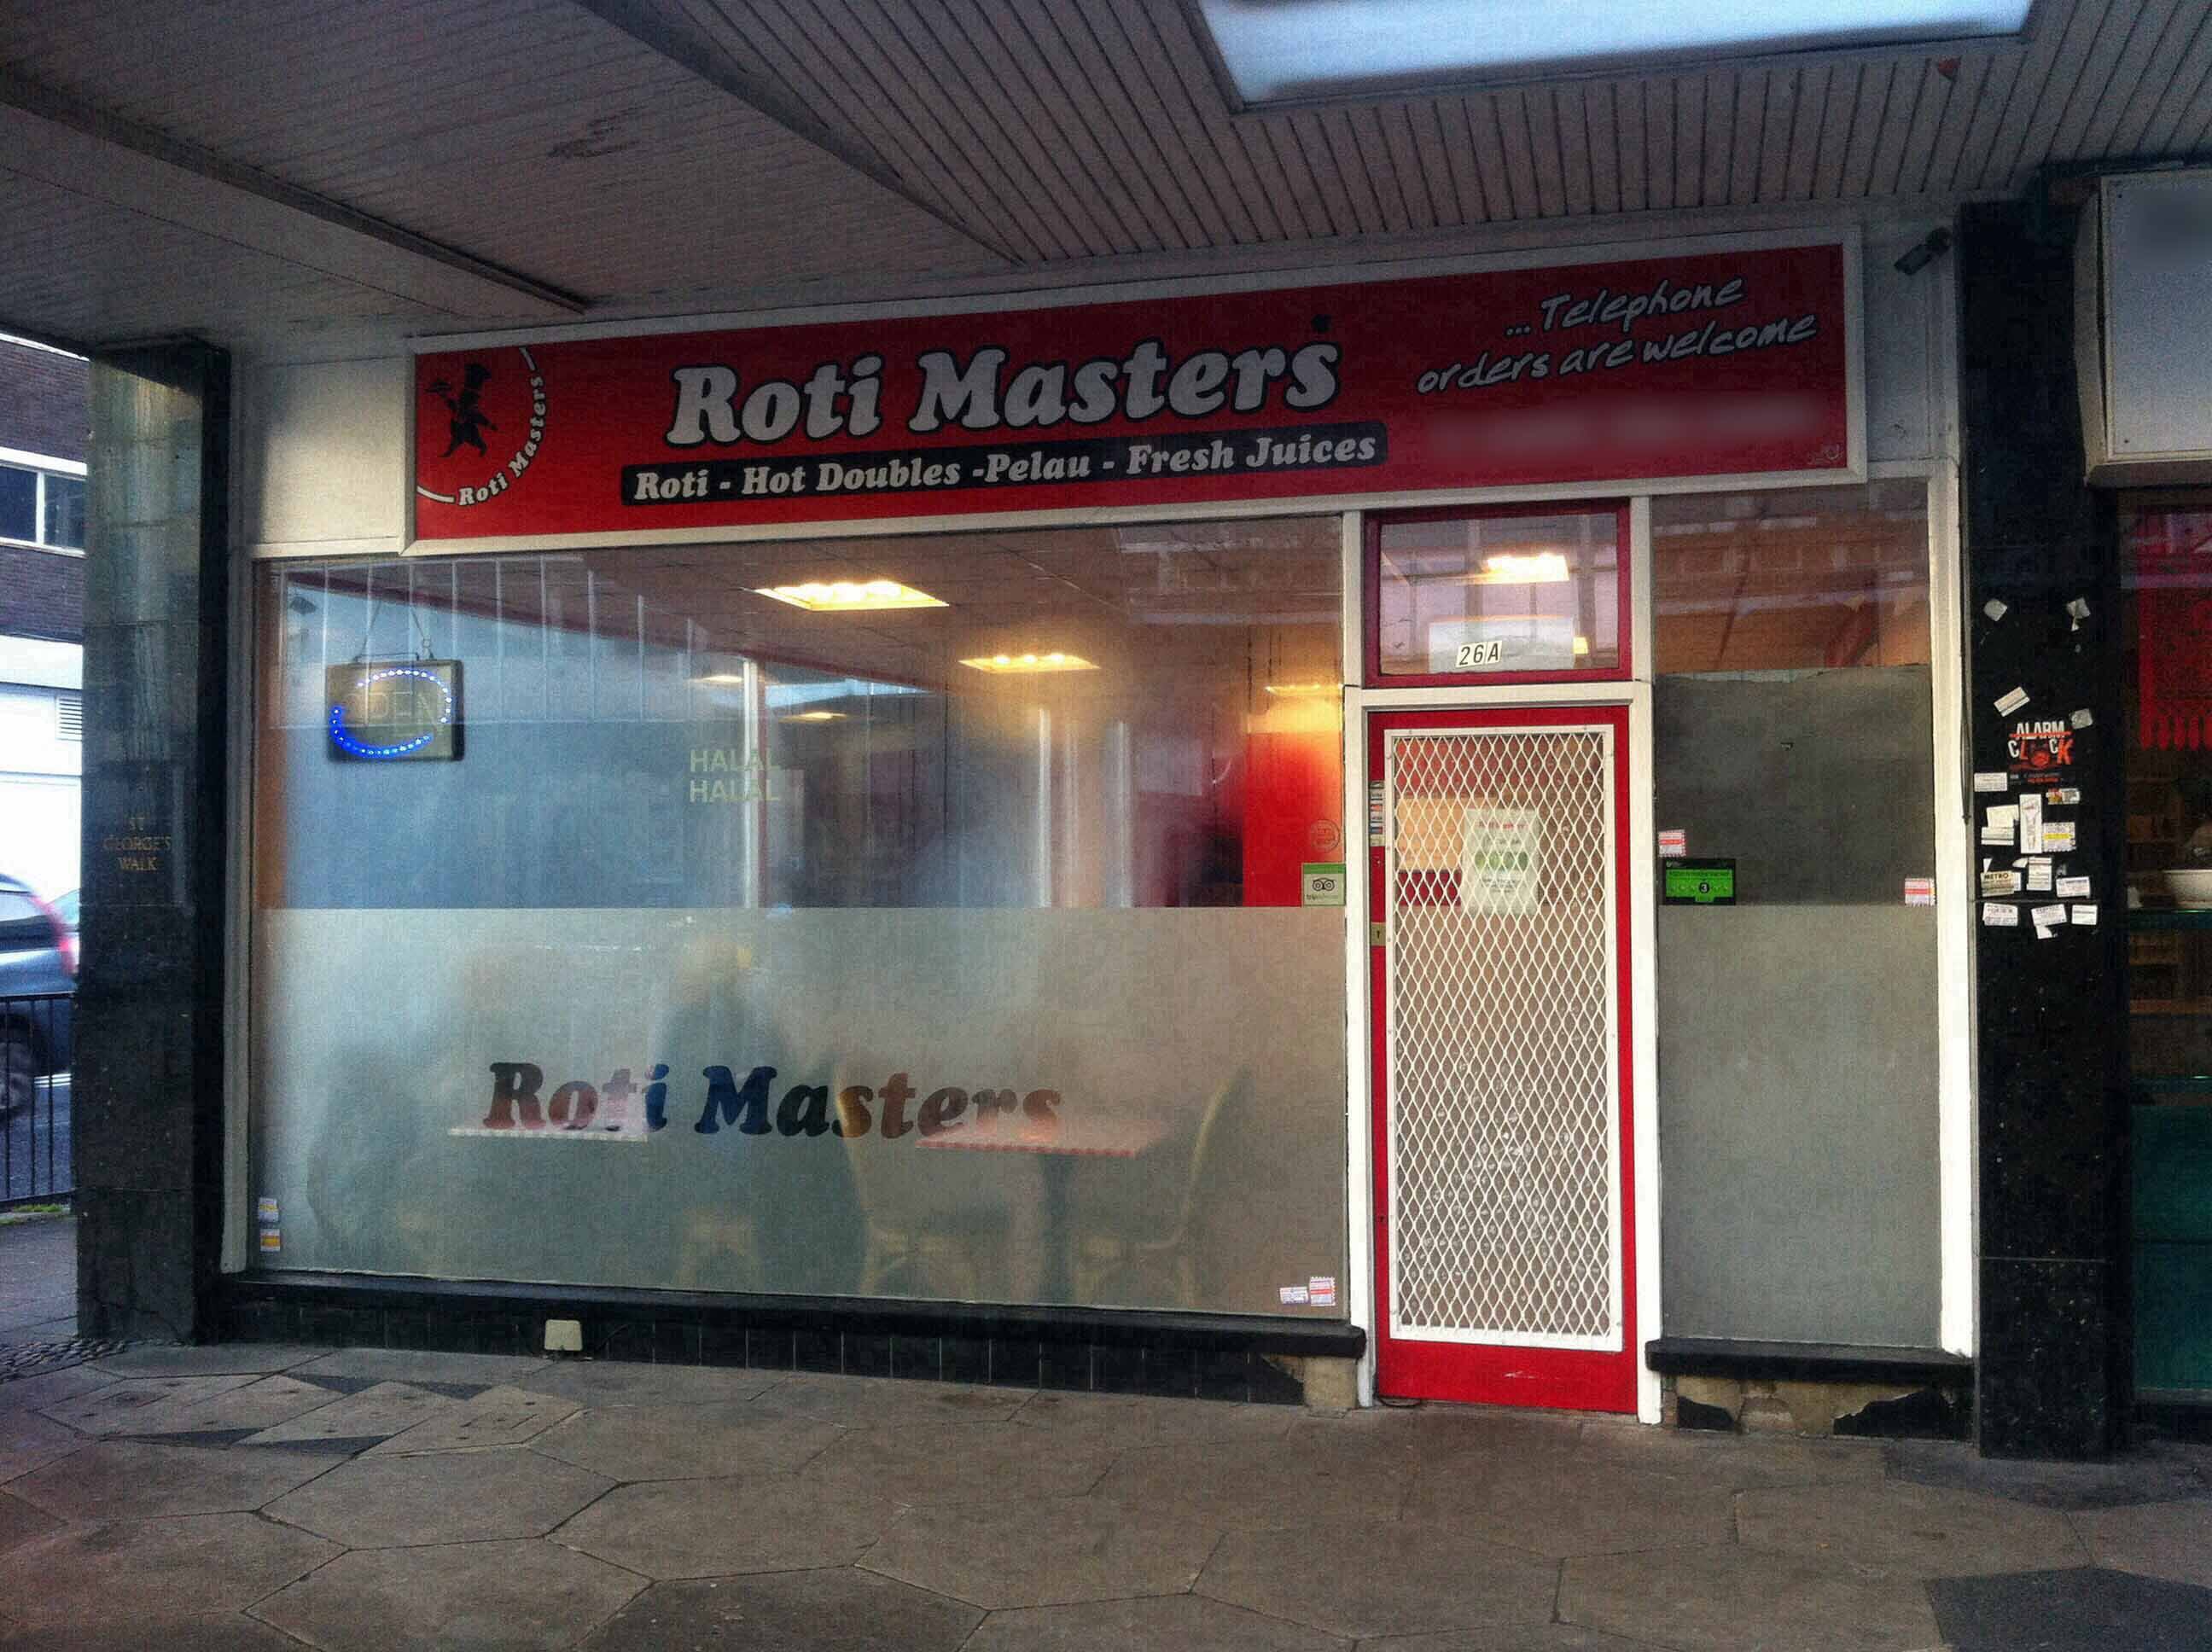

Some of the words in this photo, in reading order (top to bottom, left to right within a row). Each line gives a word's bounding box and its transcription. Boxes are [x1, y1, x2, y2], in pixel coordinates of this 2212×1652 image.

[1417, 348, 1549, 393] orders
[1559, 337, 1633, 374] are
[1643, 314, 1817, 362] welcome
[666, 355, 884, 445] Roti
[458, 474, 508, 506] Roti
[508, 375, 546, 479] Masters
[633, 468, 709, 501] Roti
[742, 465, 806, 496] Hot
[816, 457, 961, 492] Doubles
[1126, 439, 1234, 474] Fresh
[1245, 433, 1377, 467] Juices
[1459, 643, 1501, 666] 26A
[690, 748, 780, 771] HALAL
[2015, 720, 2065, 740] ALARM
[690, 778, 780, 802] HALAL
[482, 1062, 670, 1131] Roti
[694, 1064, 1062, 1139] Masters
